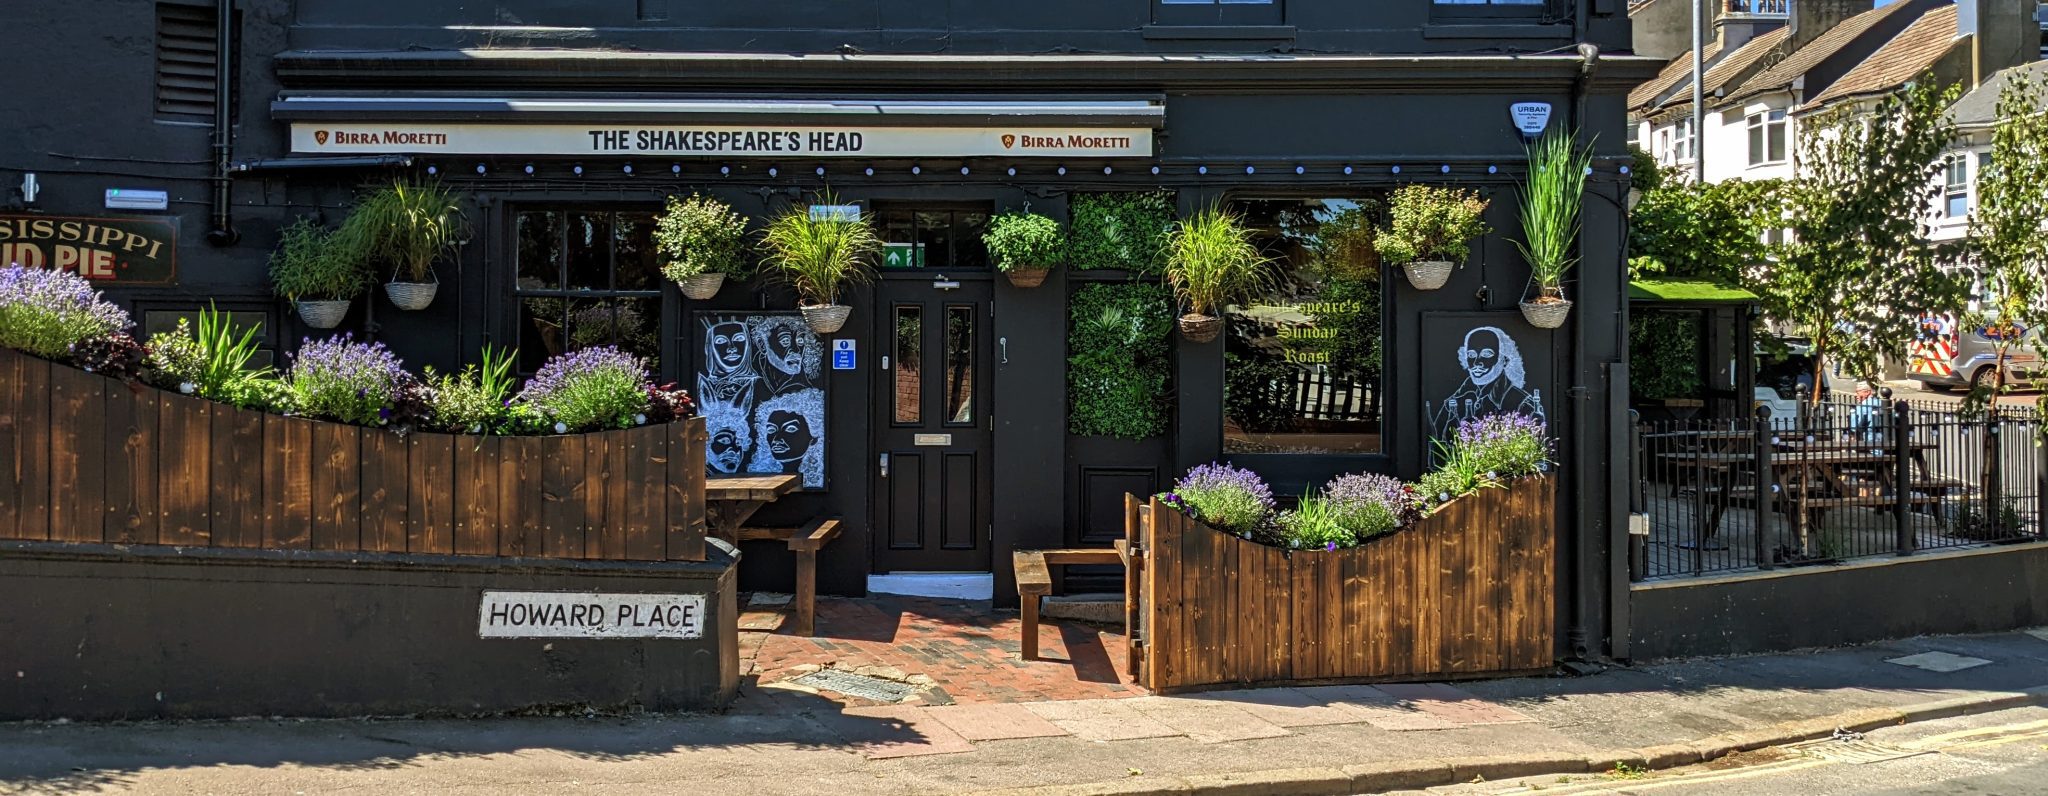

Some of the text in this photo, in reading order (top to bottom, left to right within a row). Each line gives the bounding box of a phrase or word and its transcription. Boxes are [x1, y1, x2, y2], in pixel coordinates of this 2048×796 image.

[335, 131, 447, 145] BIRRA MORETTI
[589, 130, 863, 152] THE SHAKESPEARE'S HEAD
[1021, 135, 1130, 148] BIRRA MORETTI
[54, 244, 115, 278] PIE
[1277, 323, 1338, 340] Sunday
[1284, 347, 1331, 363] Roast
[489, 603, 695, 628] HOWARD PLACE
